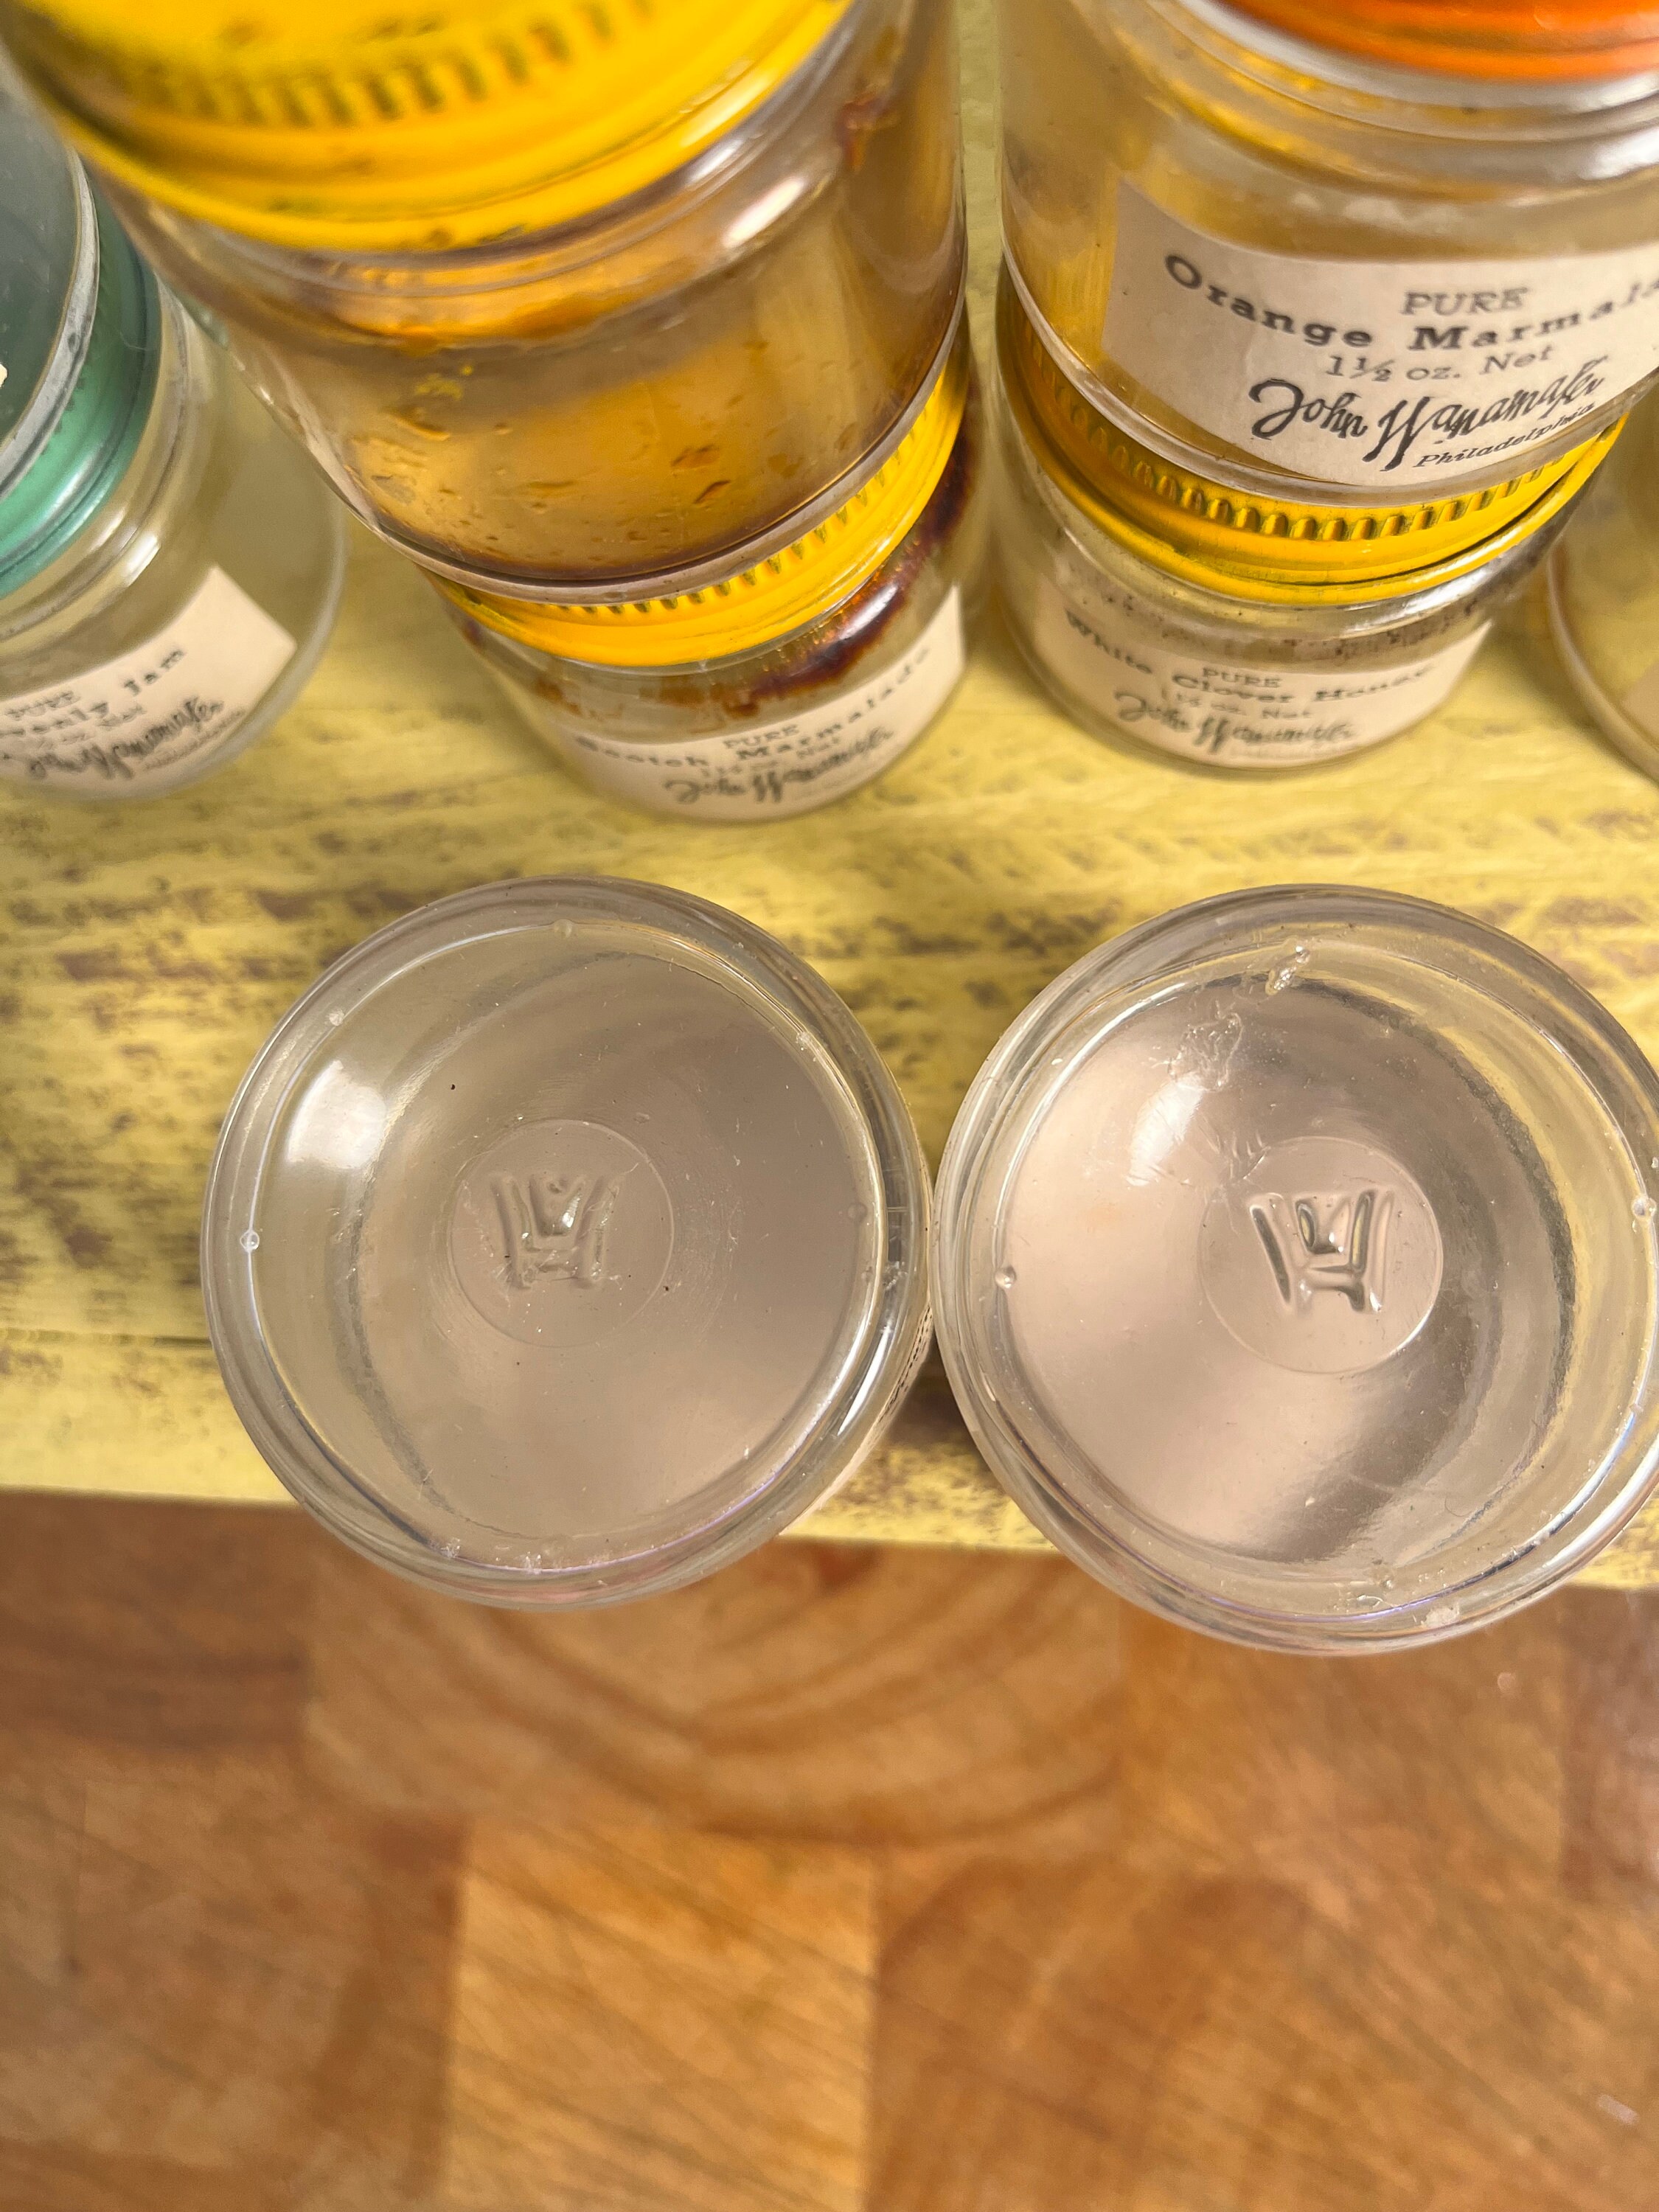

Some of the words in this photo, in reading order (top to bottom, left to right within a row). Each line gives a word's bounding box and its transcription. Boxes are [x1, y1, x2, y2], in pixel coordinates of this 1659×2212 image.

[1165, 254, 1373, 347] Orange
[1402, 285, 1529, 316] PURE
[1405, 367, 1461, 381] oz.
[1478, 344, 1552, 375] Net
[1248, 378, 1369, 441] John
[1362, 355, 1609, 472] Wanamaker
[1412, 402, 1596, 468] Philadelphia
